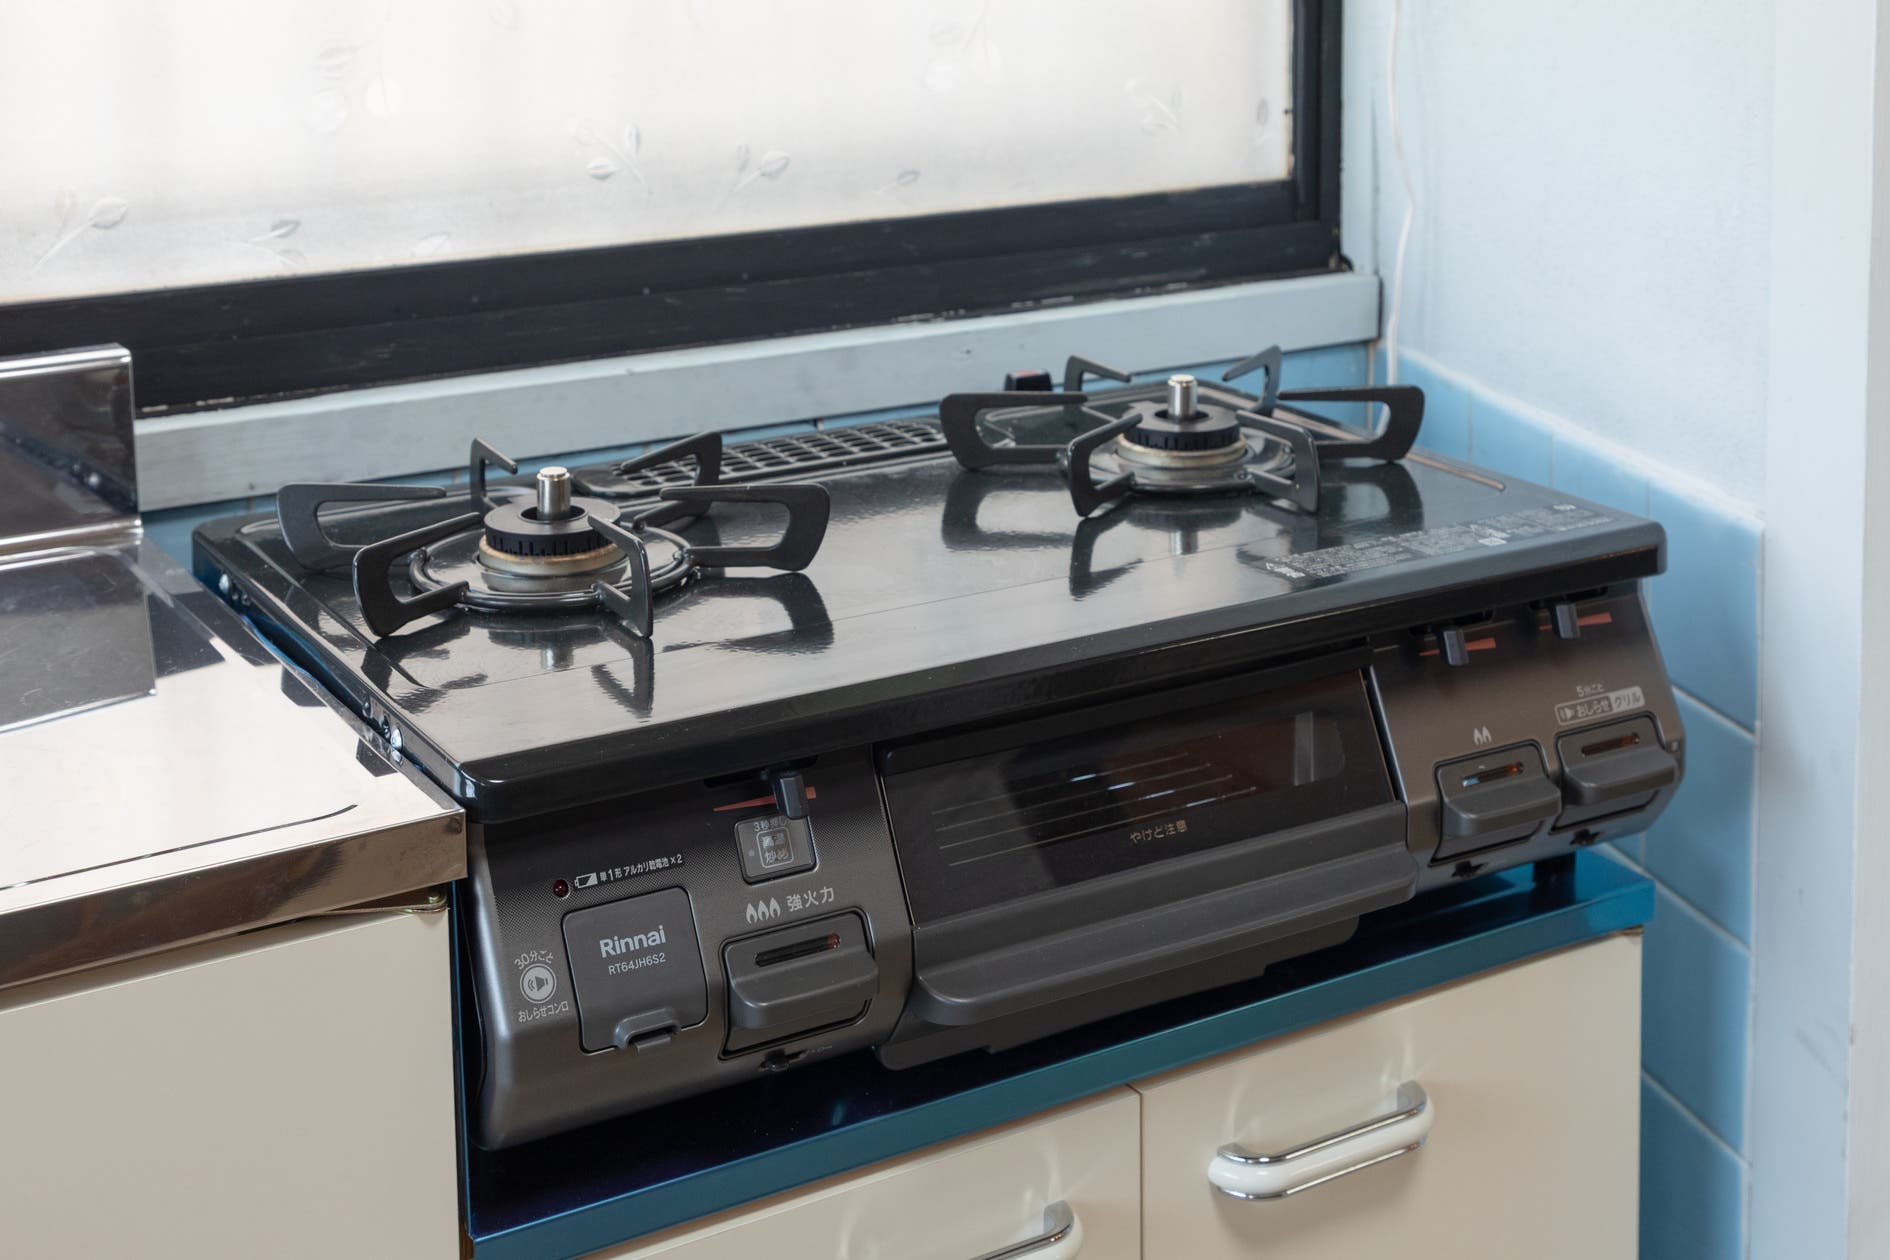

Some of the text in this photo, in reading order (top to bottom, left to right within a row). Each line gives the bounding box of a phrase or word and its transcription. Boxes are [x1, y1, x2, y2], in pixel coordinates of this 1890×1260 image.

[1129, 820, 1188, 844] やけど注意
[786, 886, 835, 912] 強火力
[599, 924, 667, 958] Rinnai
[608, 952, 666, 976] RT64JH6S2
[518, 1001, 569, 1023] おしらせコンロ
